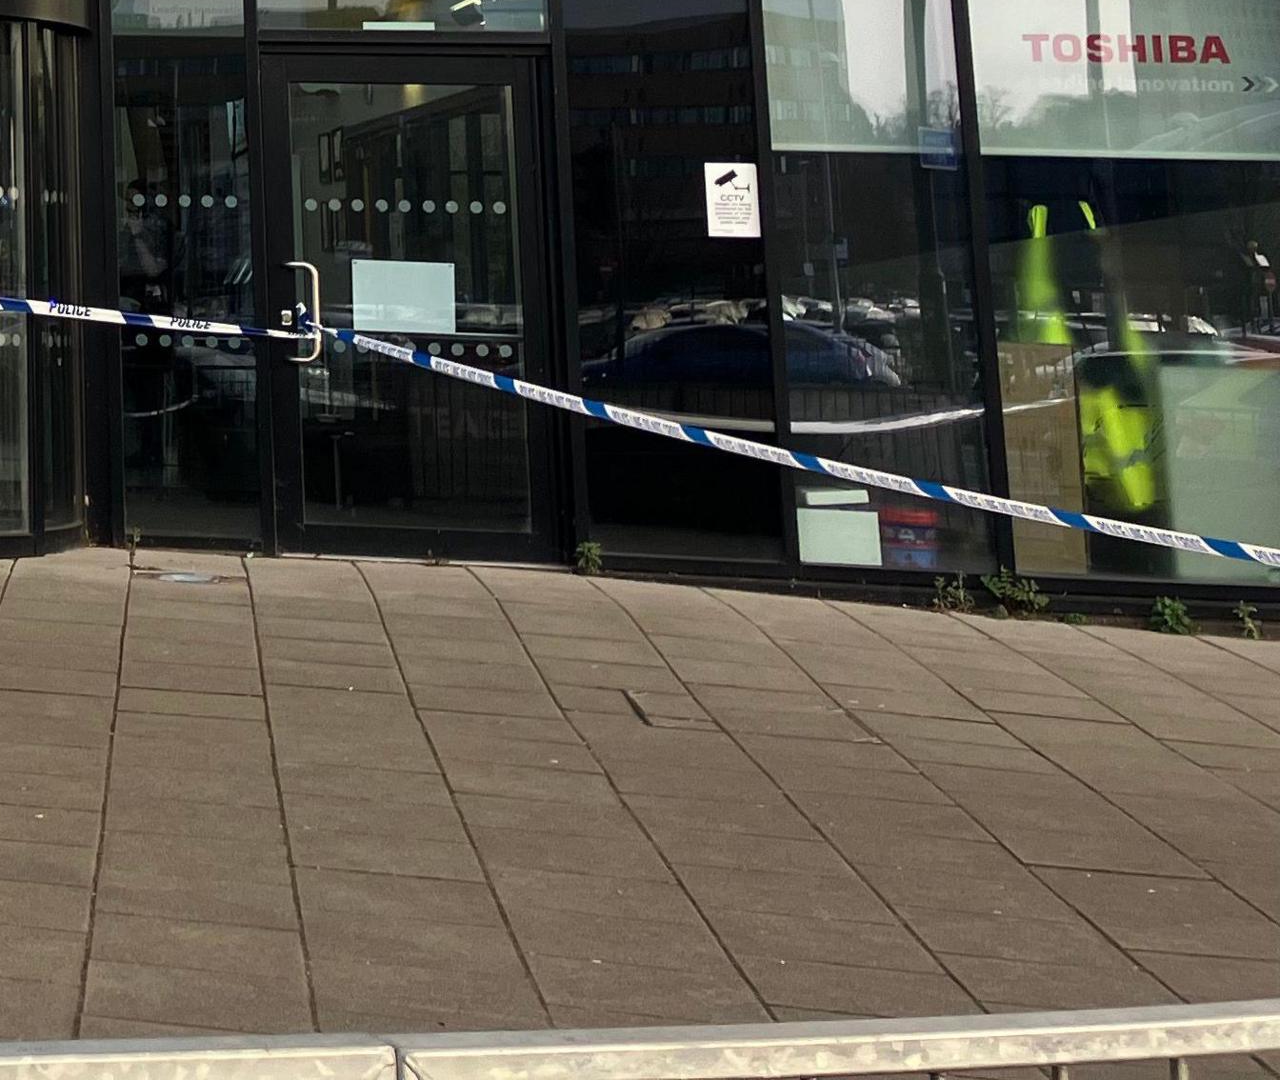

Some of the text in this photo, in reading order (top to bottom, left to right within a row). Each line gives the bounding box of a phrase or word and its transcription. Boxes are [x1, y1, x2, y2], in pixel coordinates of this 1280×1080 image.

[1022, 34, 1231, 64] TOSHIBA
[720, 194, 744, 202] CCTV
[48, 301, 92, 317] POLICE
[169, 316, 211, 330] POLICE
